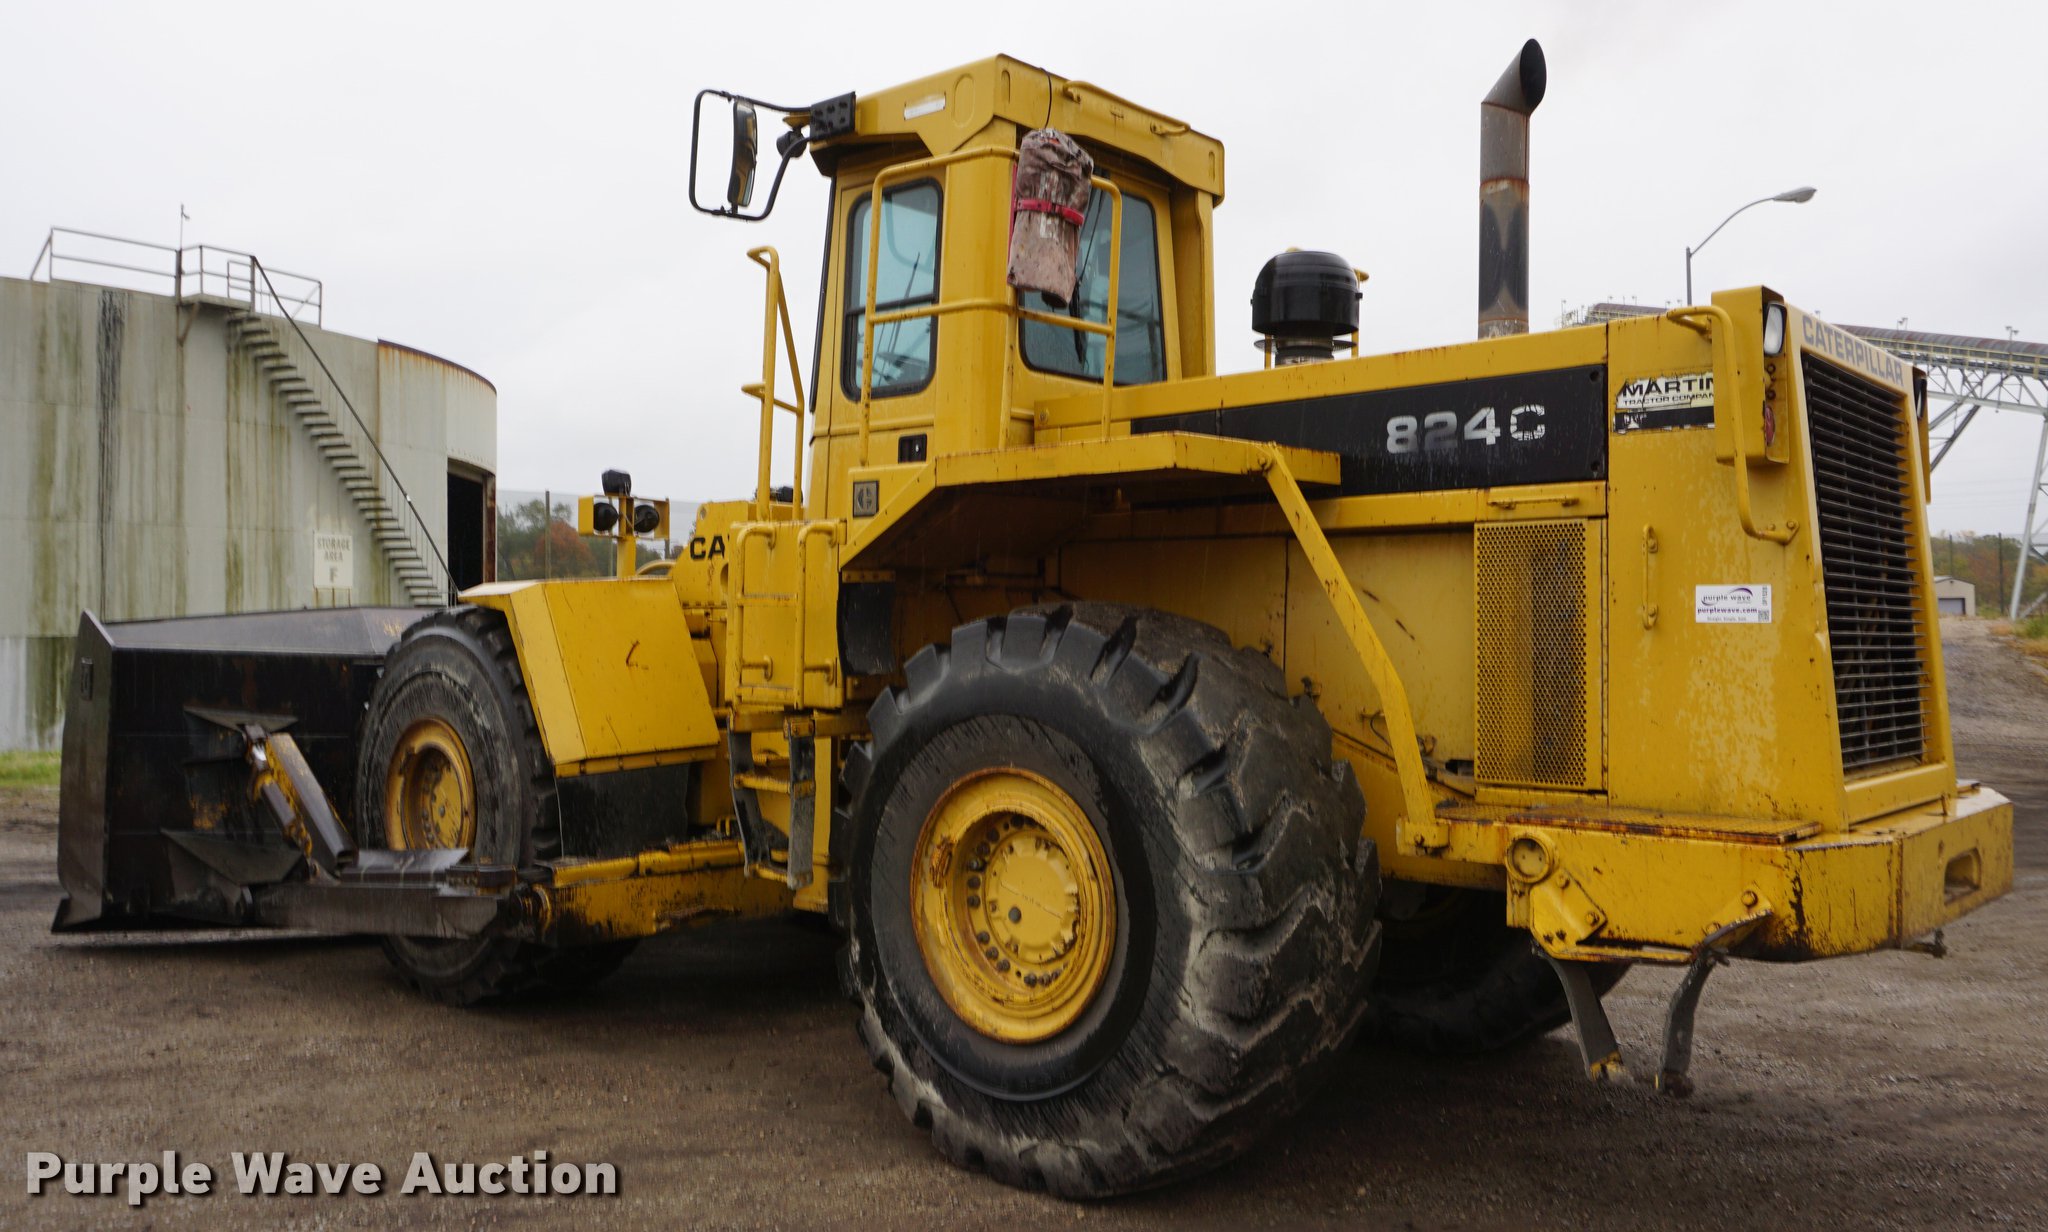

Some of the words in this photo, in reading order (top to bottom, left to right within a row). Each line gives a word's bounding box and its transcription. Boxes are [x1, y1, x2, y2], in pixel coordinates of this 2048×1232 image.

[1802, 314, 1904, 387] CATERPILLAR
[1624, 396, 1670, 406] TRACTOR
[1672, 393, 1714, 402] COMPAN
[1386, 404, 1546, 454] 824C
[690, 534, 730, 561] CA
[1703, 594, 1728, 602] purple
[1697, 606, 1758, 615] purplewave.com
